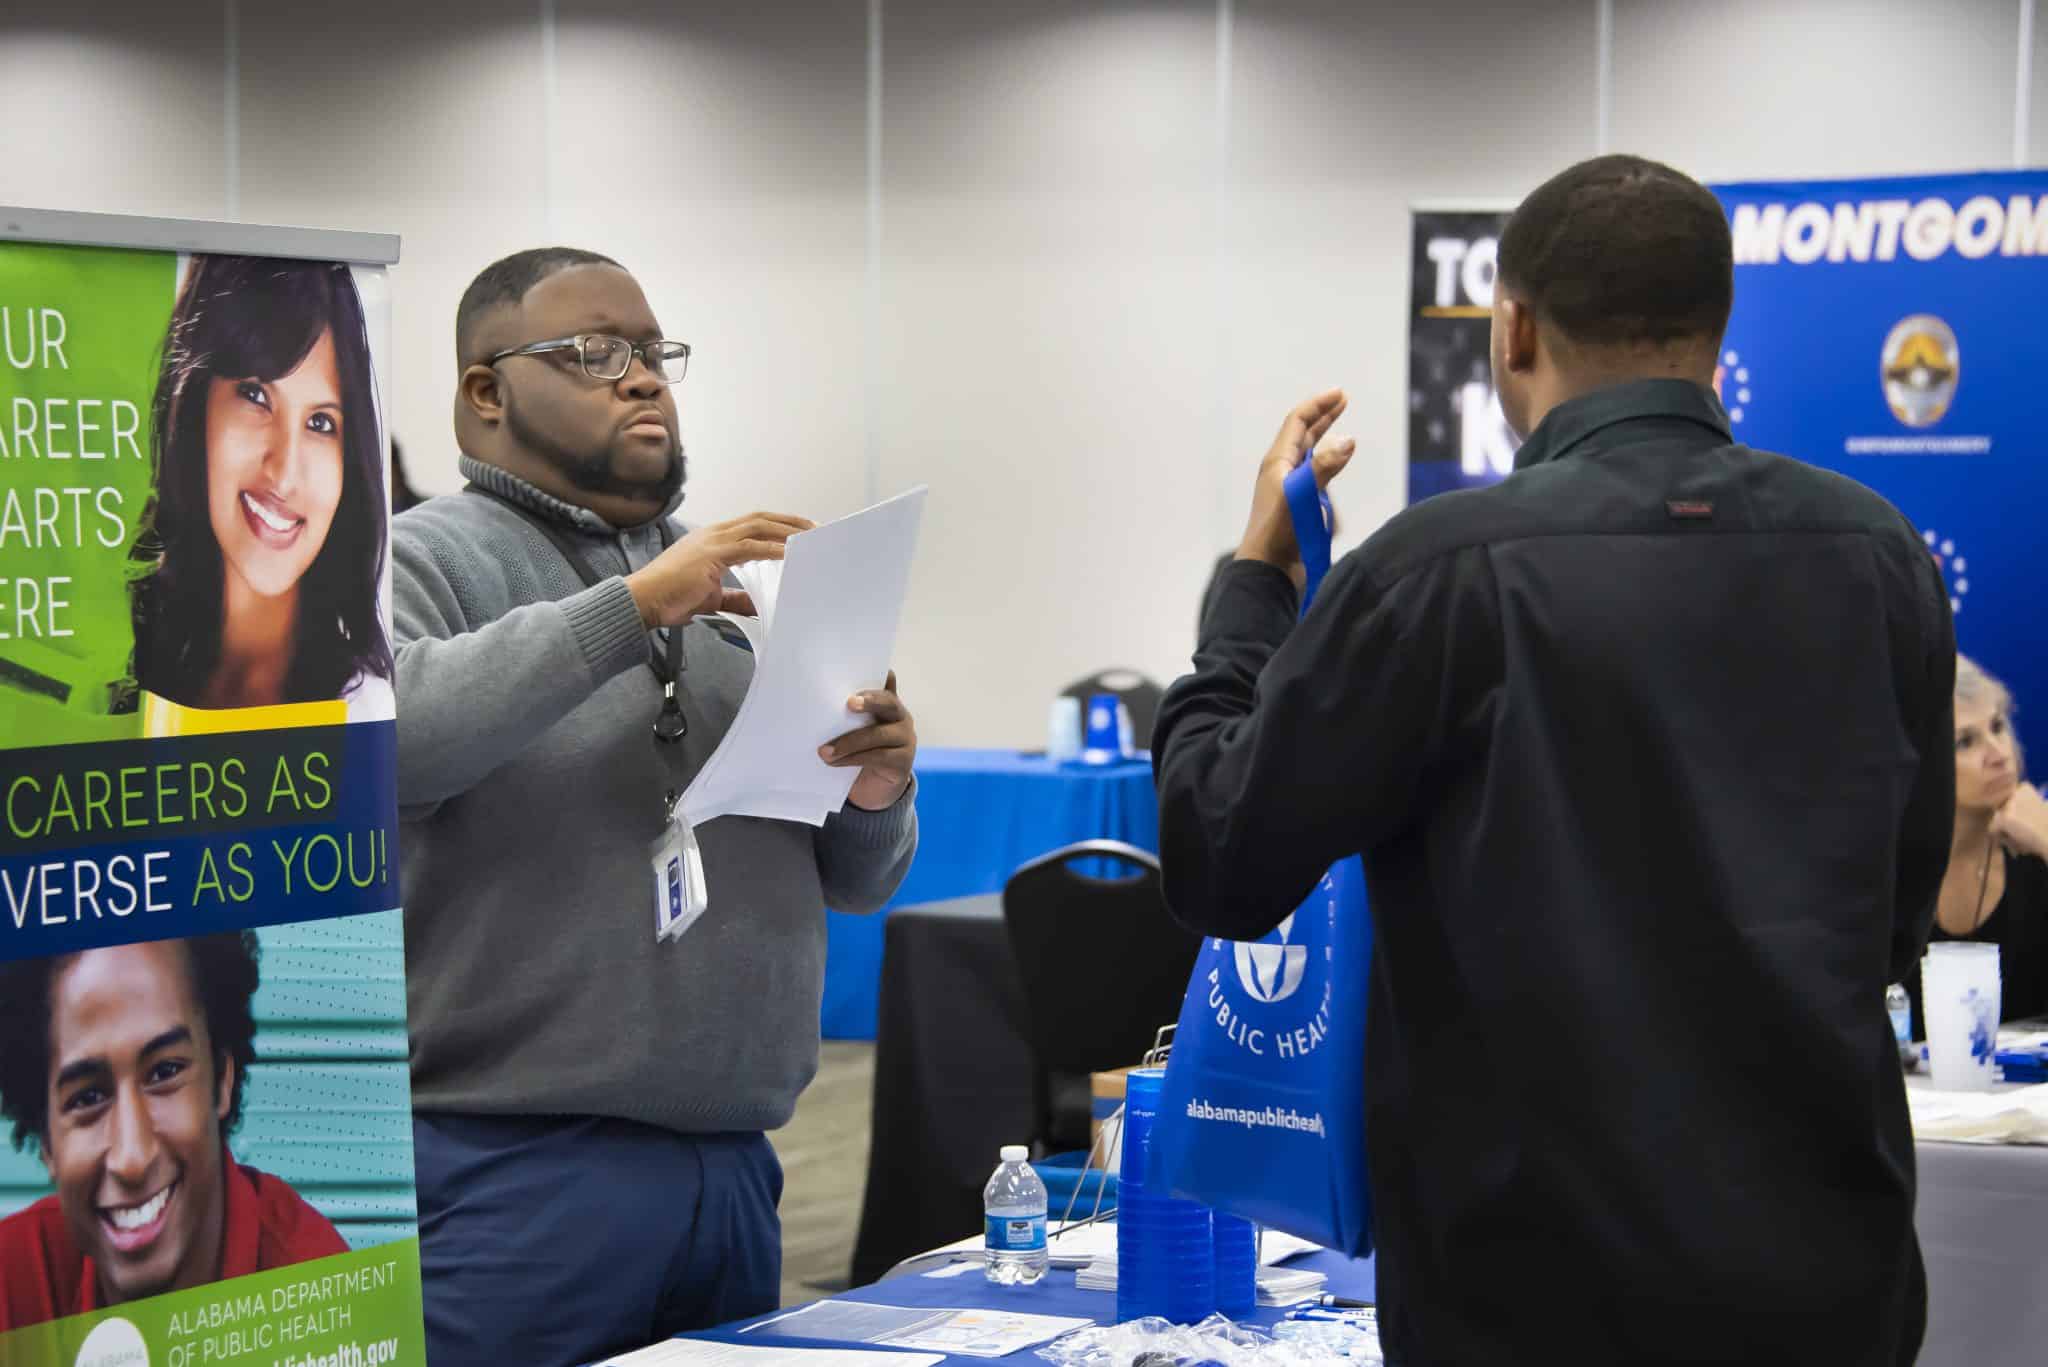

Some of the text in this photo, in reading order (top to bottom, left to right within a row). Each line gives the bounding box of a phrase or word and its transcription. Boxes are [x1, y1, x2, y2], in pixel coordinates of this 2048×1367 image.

[1732, 195, 2048, 265] MONTGOM
[3, 306, 69, 369] UR
[0, 486, 125, 548] ARTS
[7, 751, 332, 838] CAREERS AS
[1, 829, 388, 928] VERSE AS YOU!
[1207, 967, 1264, 1055] PUBLIC
[168, 1261, 397, 1339] ALABAMA DEPARTMENT
[168, 1341, 197, 1367] OF
[203, 1323, 273, 1364] PUBLIC
[279, 1304, 352, 1343] HEALTH
